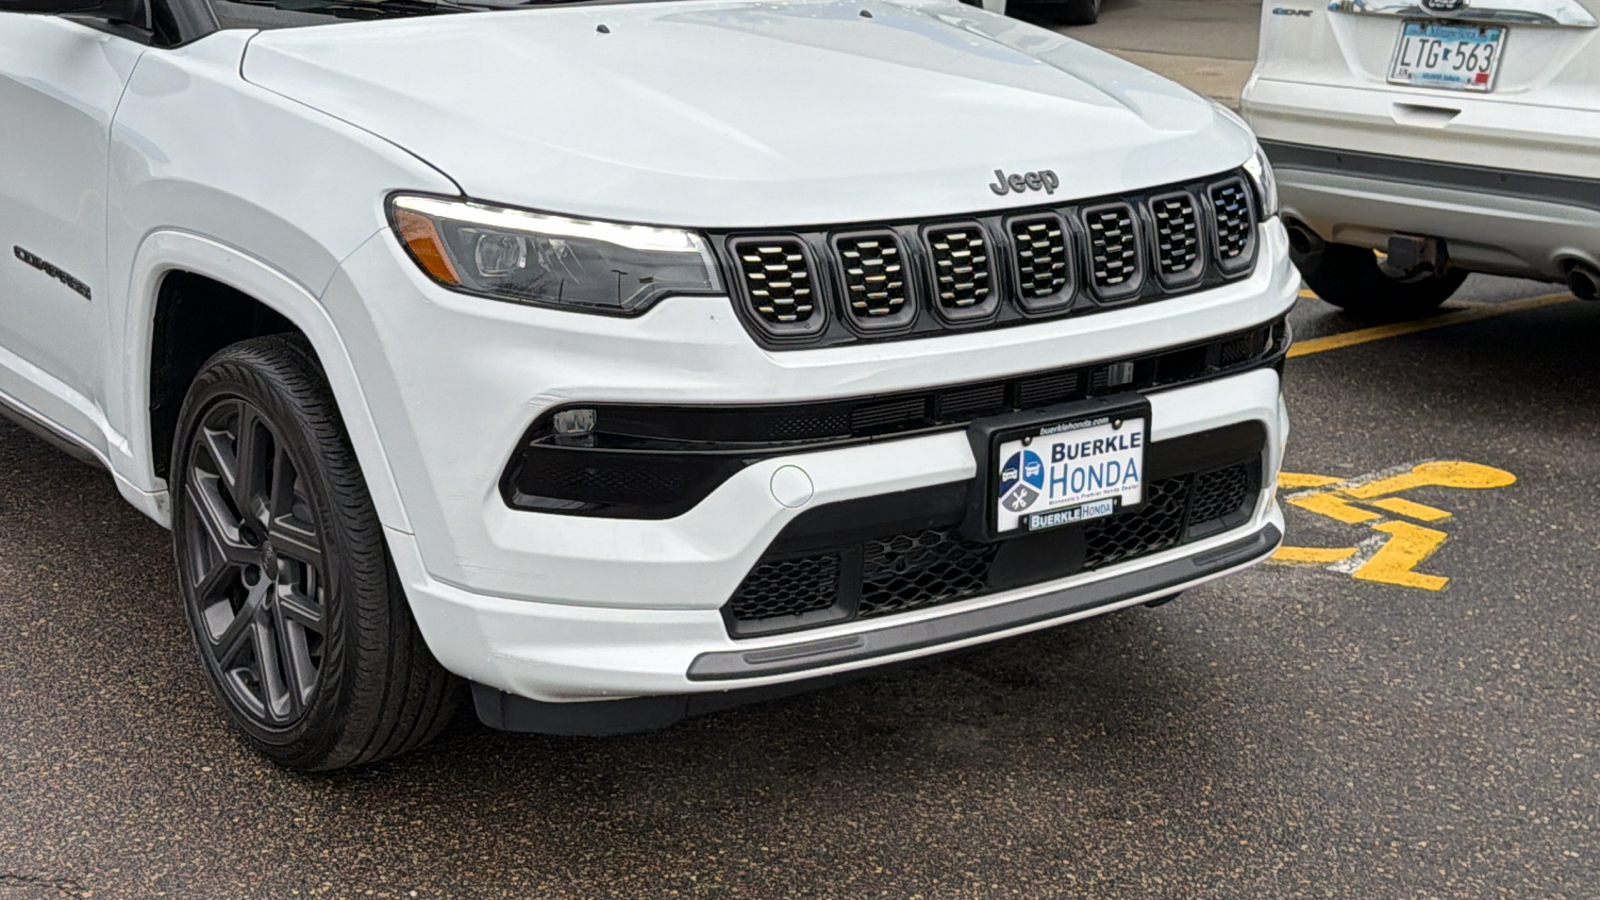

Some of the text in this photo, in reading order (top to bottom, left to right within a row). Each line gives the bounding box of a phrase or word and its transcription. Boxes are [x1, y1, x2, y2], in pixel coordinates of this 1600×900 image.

[1400, 37, 1494, 72] LTG 563
[989, 168, 1060, 196] Jeep
[1040, 417, 1109, 436] buerklehonda.com
[1051, 432, 1141, 464] BUERKLE
[1049, 457, 1139, 499] HONDA
